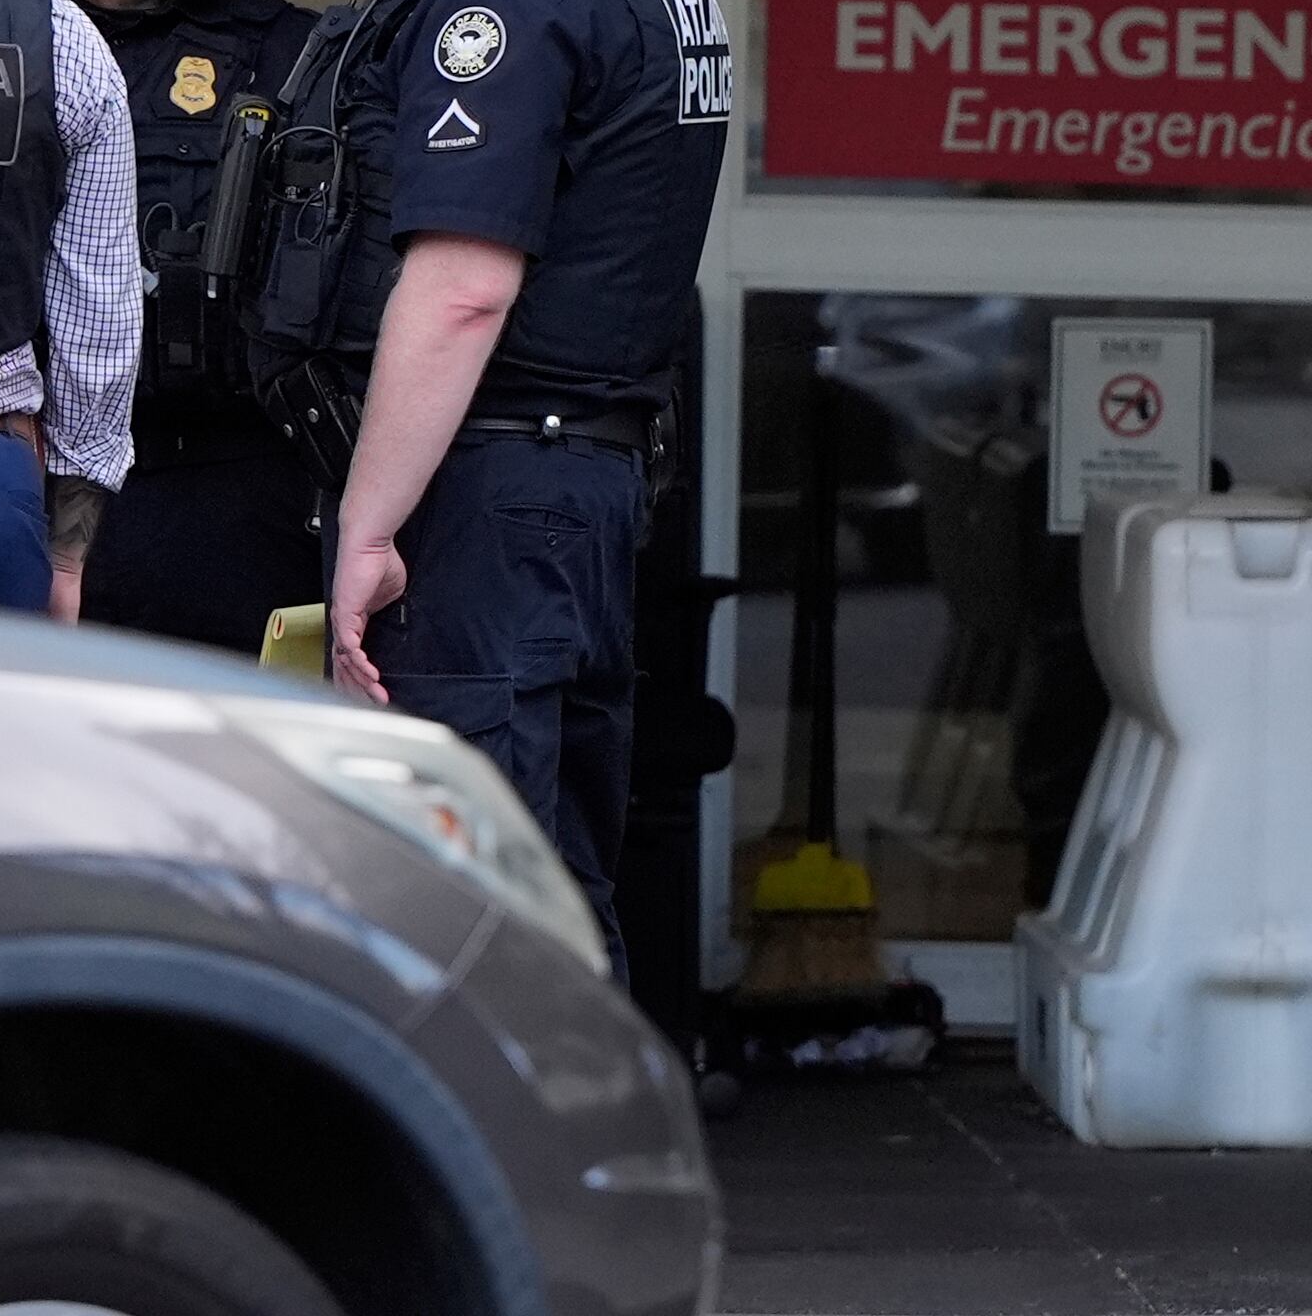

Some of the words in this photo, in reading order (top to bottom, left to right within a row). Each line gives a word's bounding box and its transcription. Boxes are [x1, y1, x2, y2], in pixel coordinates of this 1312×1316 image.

[440, 25, 455, 49] CITY
[455, 14, 471, 26] OF
[472, 13, 500, 48] ATLANTA
[443, 58, 487, 75] POLICE
